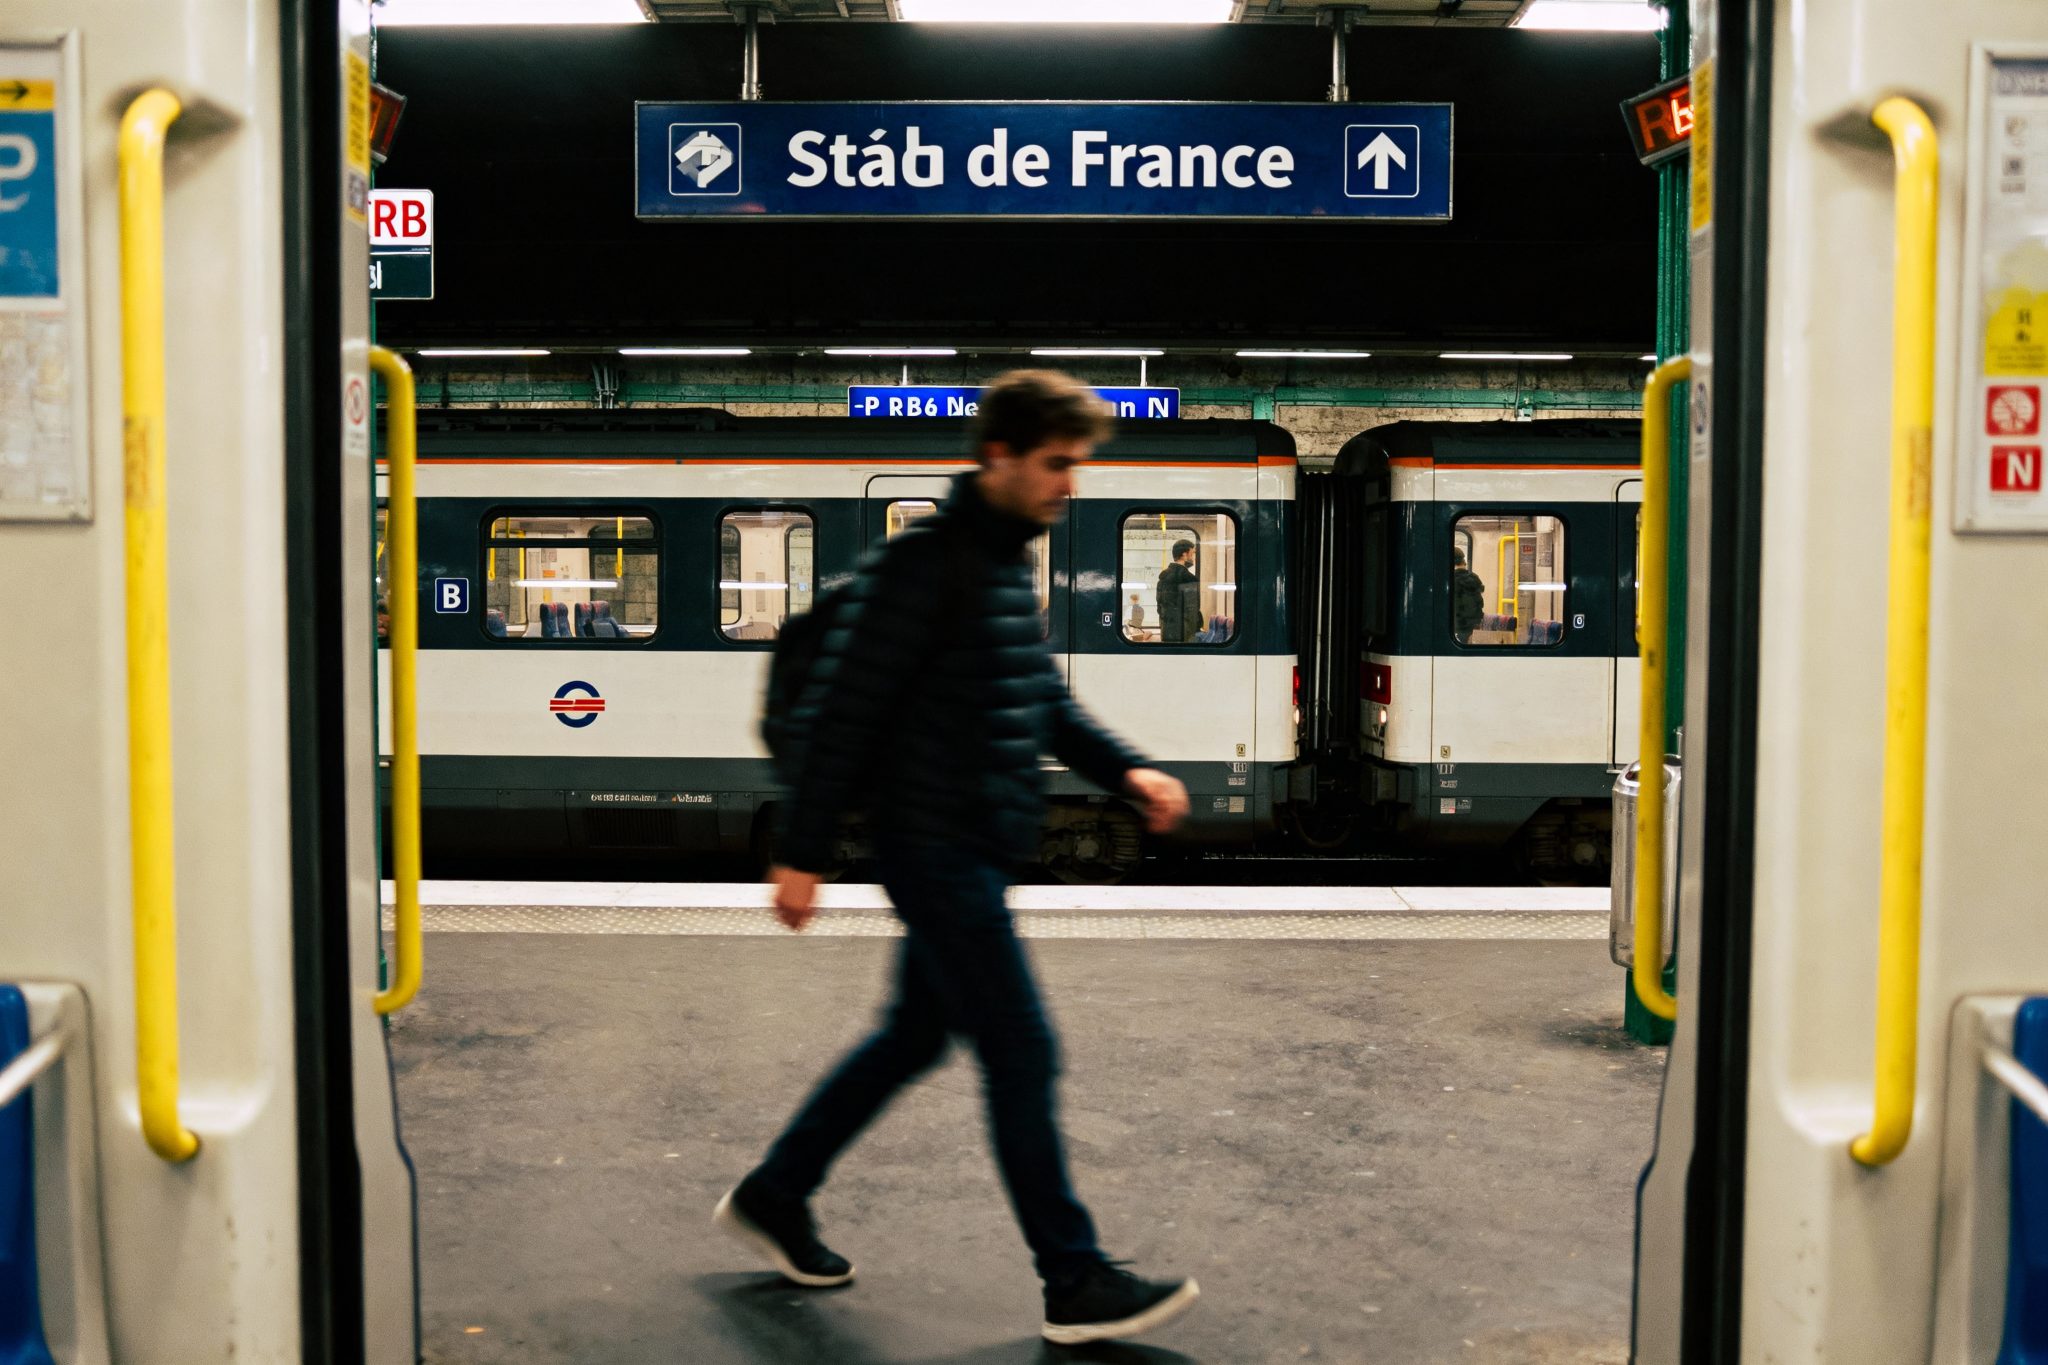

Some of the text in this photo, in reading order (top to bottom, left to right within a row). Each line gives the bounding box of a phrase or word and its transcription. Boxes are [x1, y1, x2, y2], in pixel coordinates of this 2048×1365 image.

[967, 128, 1048, 188] de
[1072, 130, 1294, 188] France
[369, 200, 427, 237] RB
[1148, 397, 1169, 418] N
[2007, 451, 2034, 486] N
[443, 583, 461, 608] B
